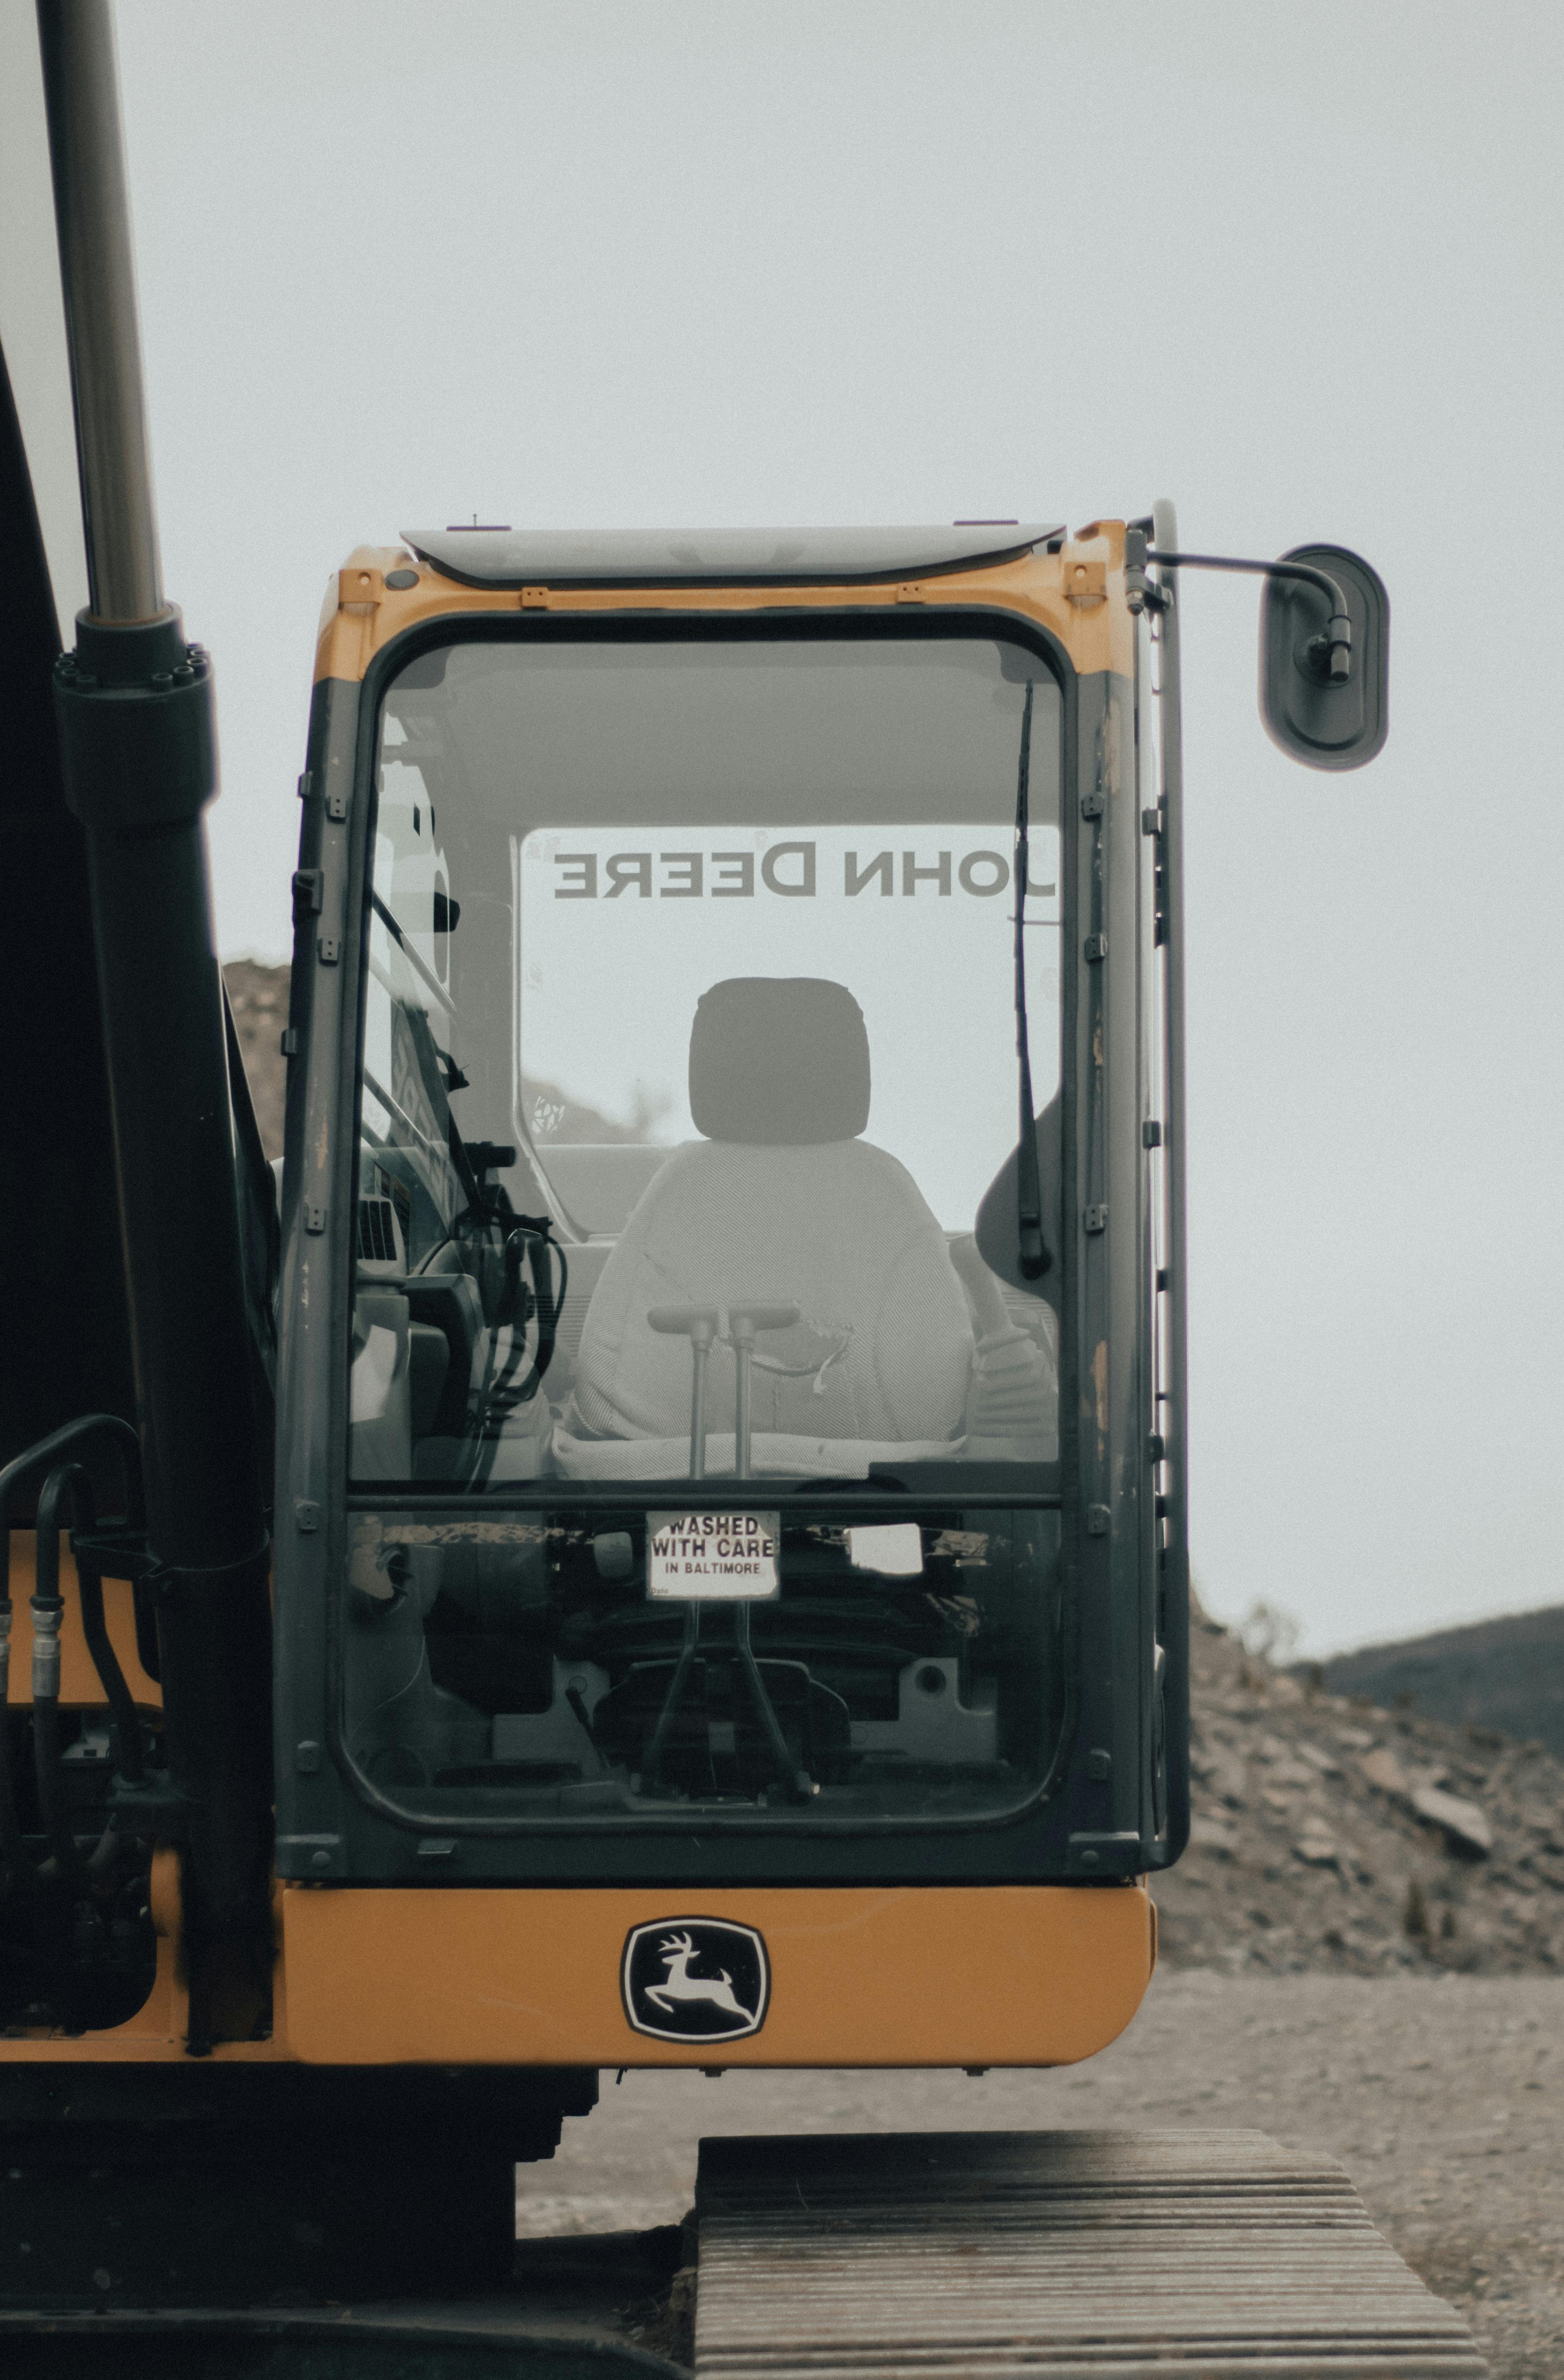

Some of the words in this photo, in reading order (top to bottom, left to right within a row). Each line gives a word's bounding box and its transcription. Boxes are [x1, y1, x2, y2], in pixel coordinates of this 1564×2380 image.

[670, 1516, 758, 1535] WASHED
[652, 1538, 706, 1557] WITH
[717, 1538, 773, 1557] CARE
[665, 1562, 678, 1573] IN
[685, 1562, 760, 1574] BALTIMORE
